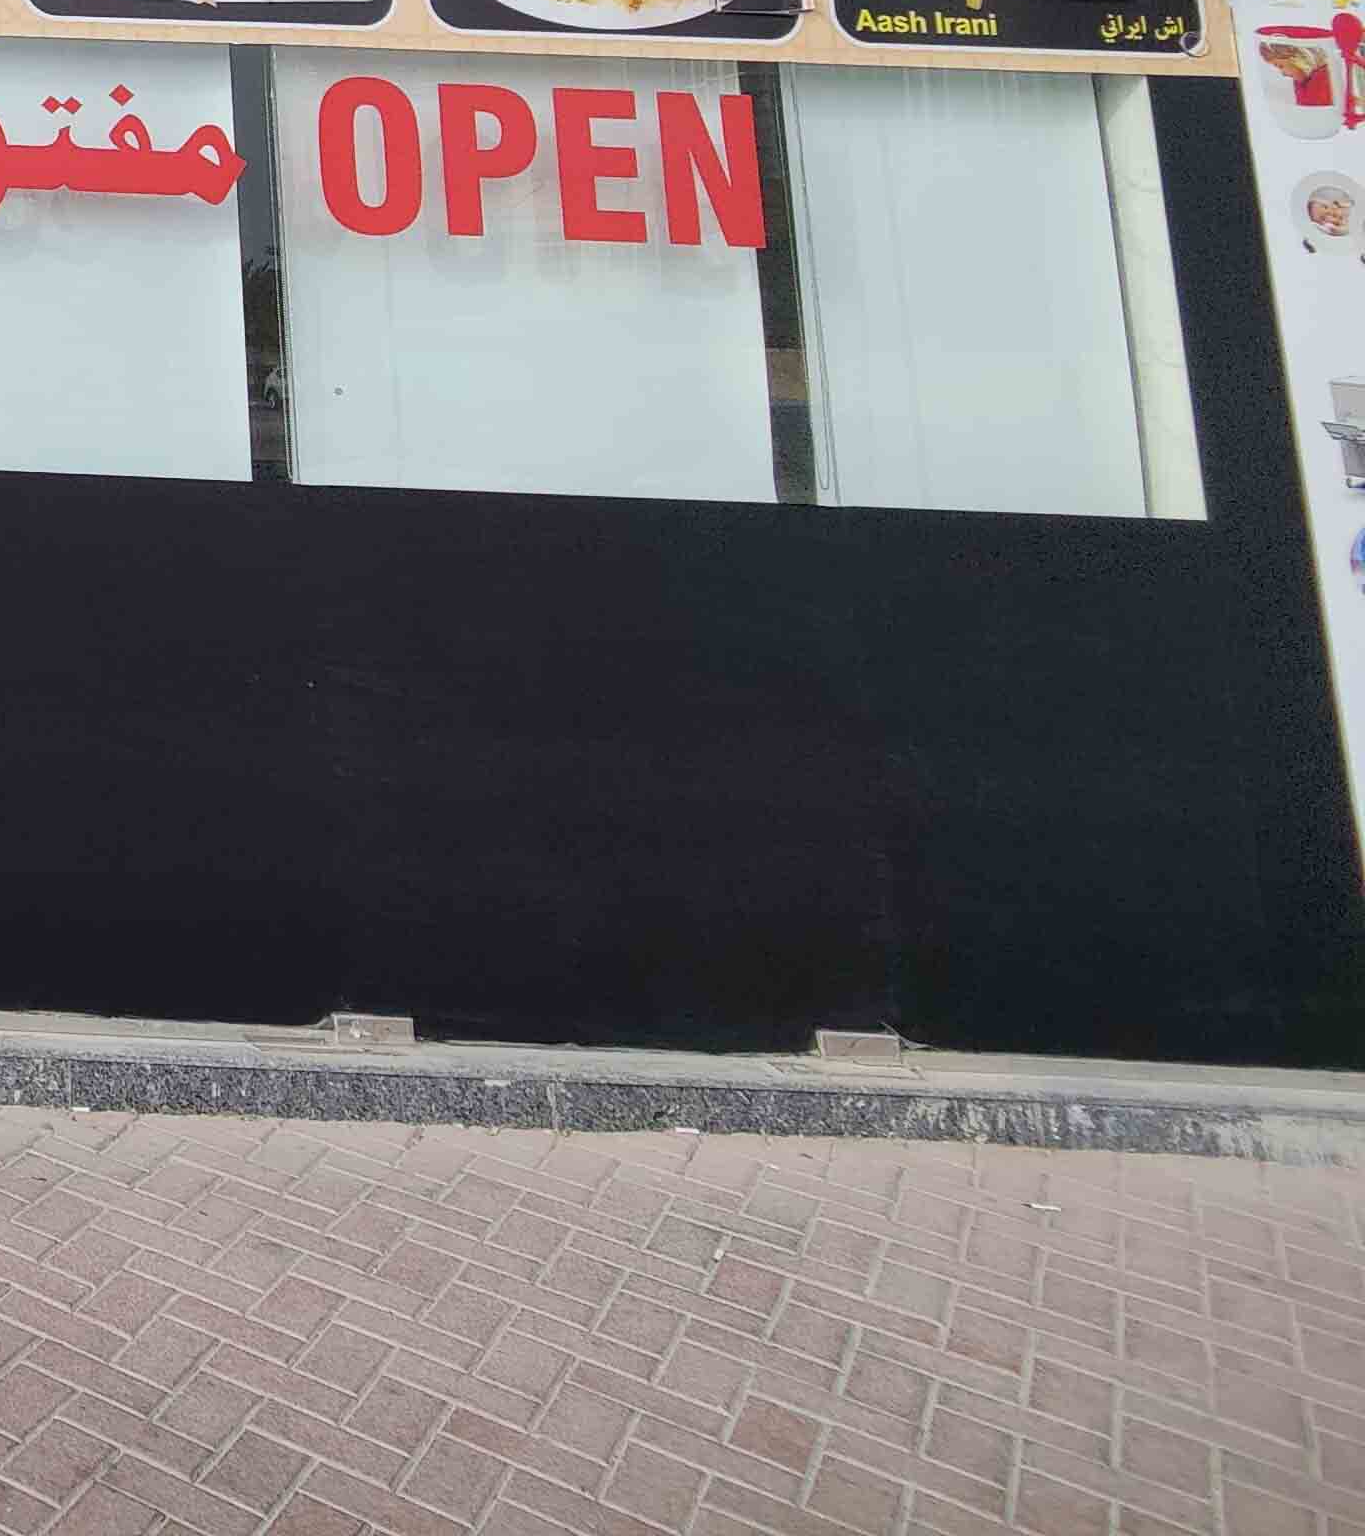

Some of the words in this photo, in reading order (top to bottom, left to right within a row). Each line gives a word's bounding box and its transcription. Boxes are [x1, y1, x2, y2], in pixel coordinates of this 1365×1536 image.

[855, 9, 927, 34] Aash
[934, 11, 998, 37] Irani
[318, 76, 767, 250] OPEN
